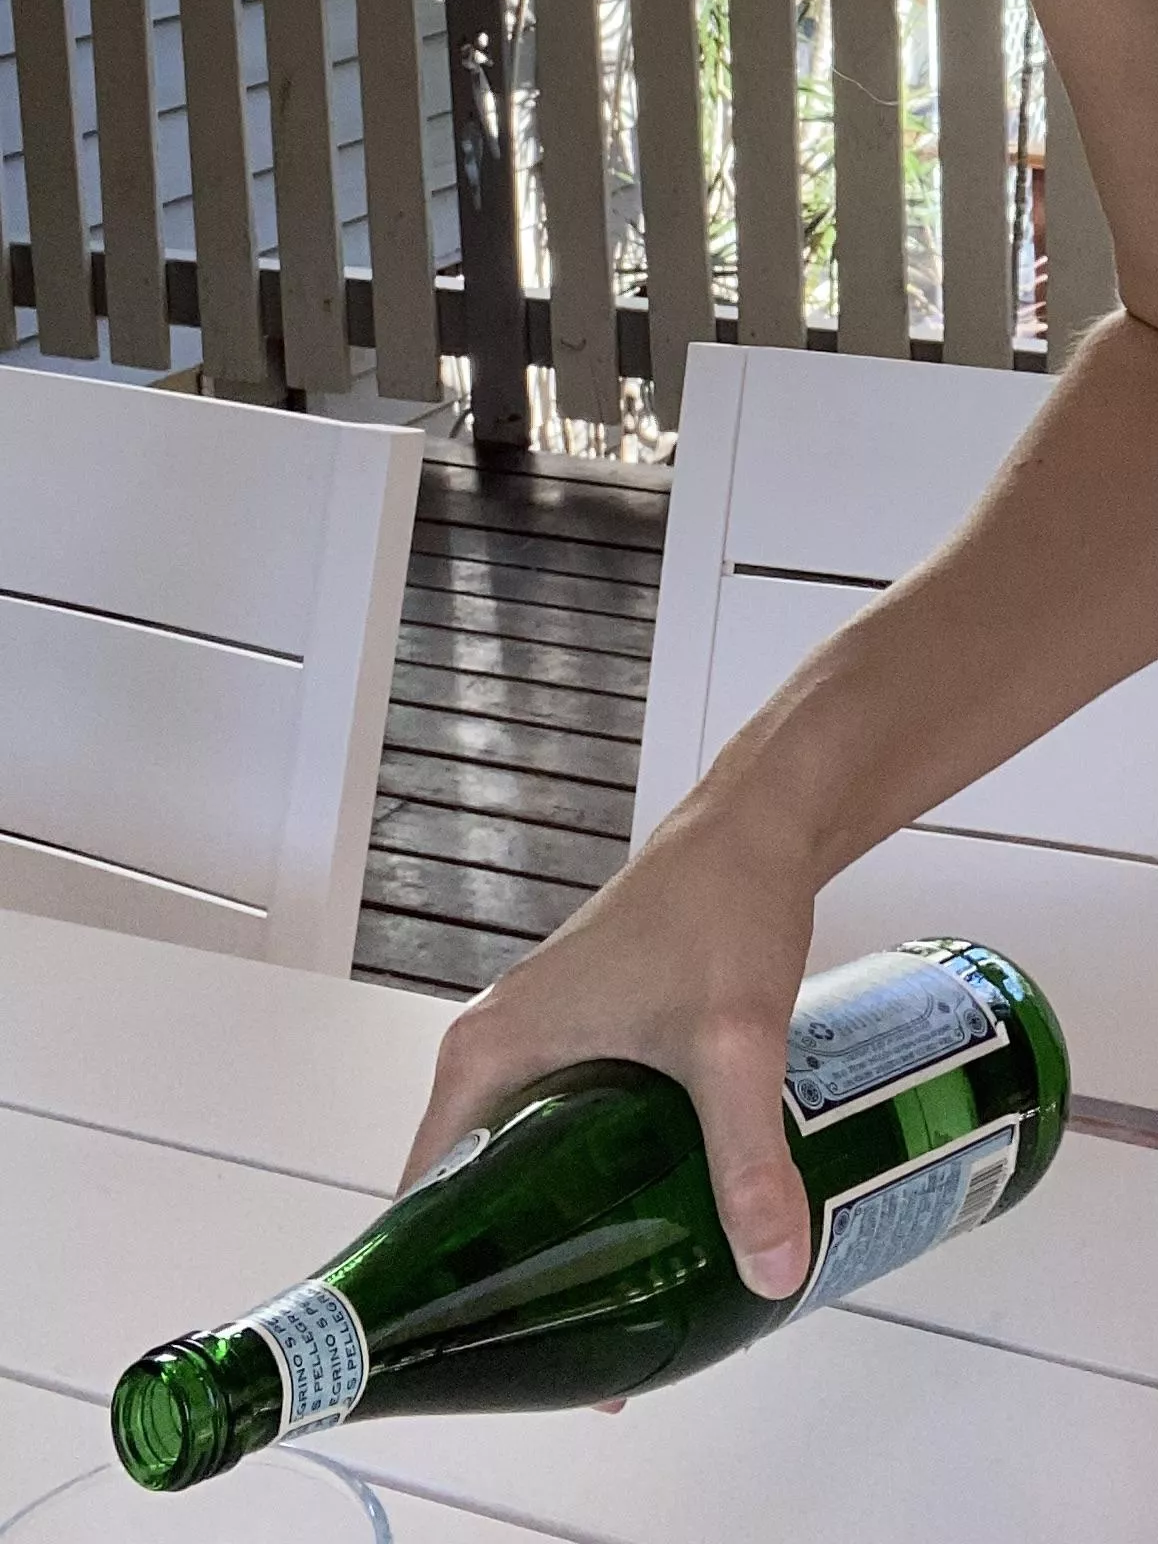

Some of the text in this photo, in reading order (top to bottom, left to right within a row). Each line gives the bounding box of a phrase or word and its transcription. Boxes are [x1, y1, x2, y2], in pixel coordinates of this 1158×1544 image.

[316, 1317, 328, 1329] S
[285, 1336, 297, 1349] S
[346, 1377, 357, 1391] S
[311, 1399, 322, 1411] S
